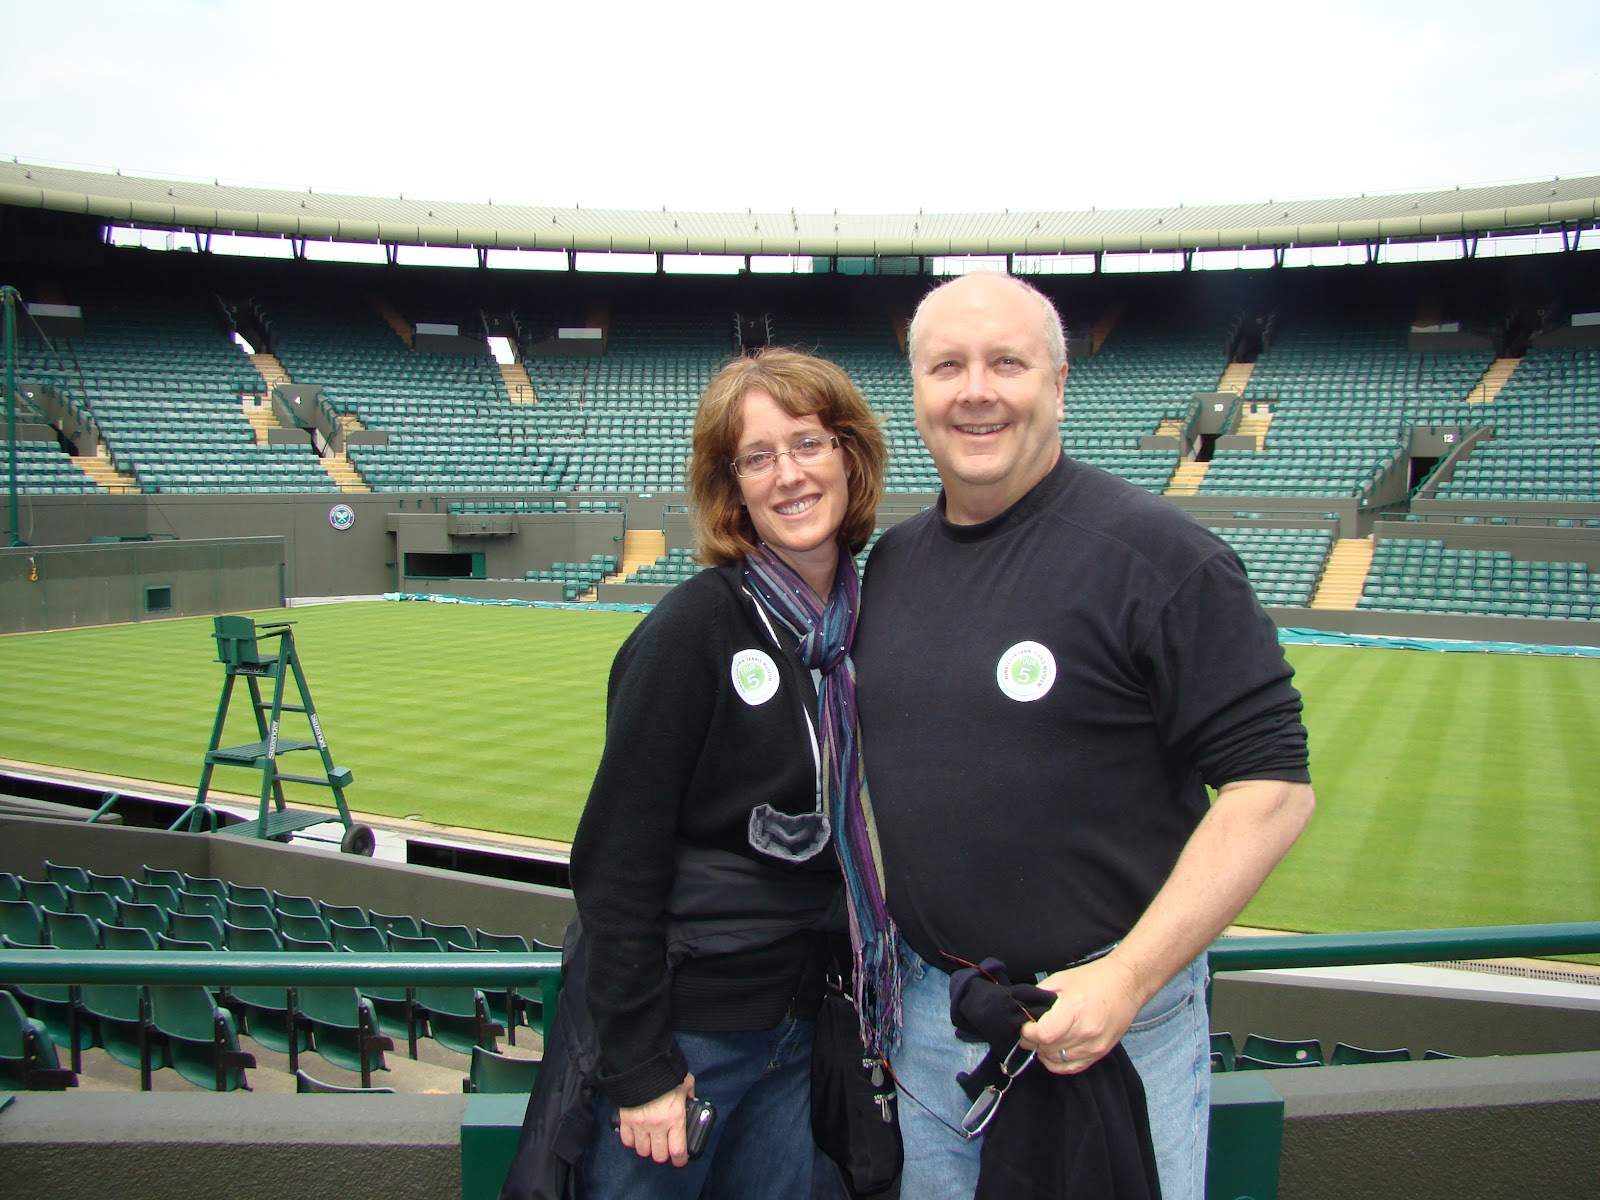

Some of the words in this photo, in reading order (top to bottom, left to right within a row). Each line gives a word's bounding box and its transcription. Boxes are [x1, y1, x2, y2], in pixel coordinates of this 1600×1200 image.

[294, 396, 302, 404] 4
[1213, 403, 1224, 412] 10
[1443, 433, 1454, 443] 12
[746, 656, 762, 664] TENNIS
[763, 661, 773, 682] MUSEUM
[1019, 657, 1037, 666] TOUR
[746, 672, 760, 689] 5
[1017, 667, 1031, 683] 5
[1037, 665, 1048, 688] MUSEUM
[268, 720, 280, 760] Slazenger
[310, 713, 327, 751] Slazenger
